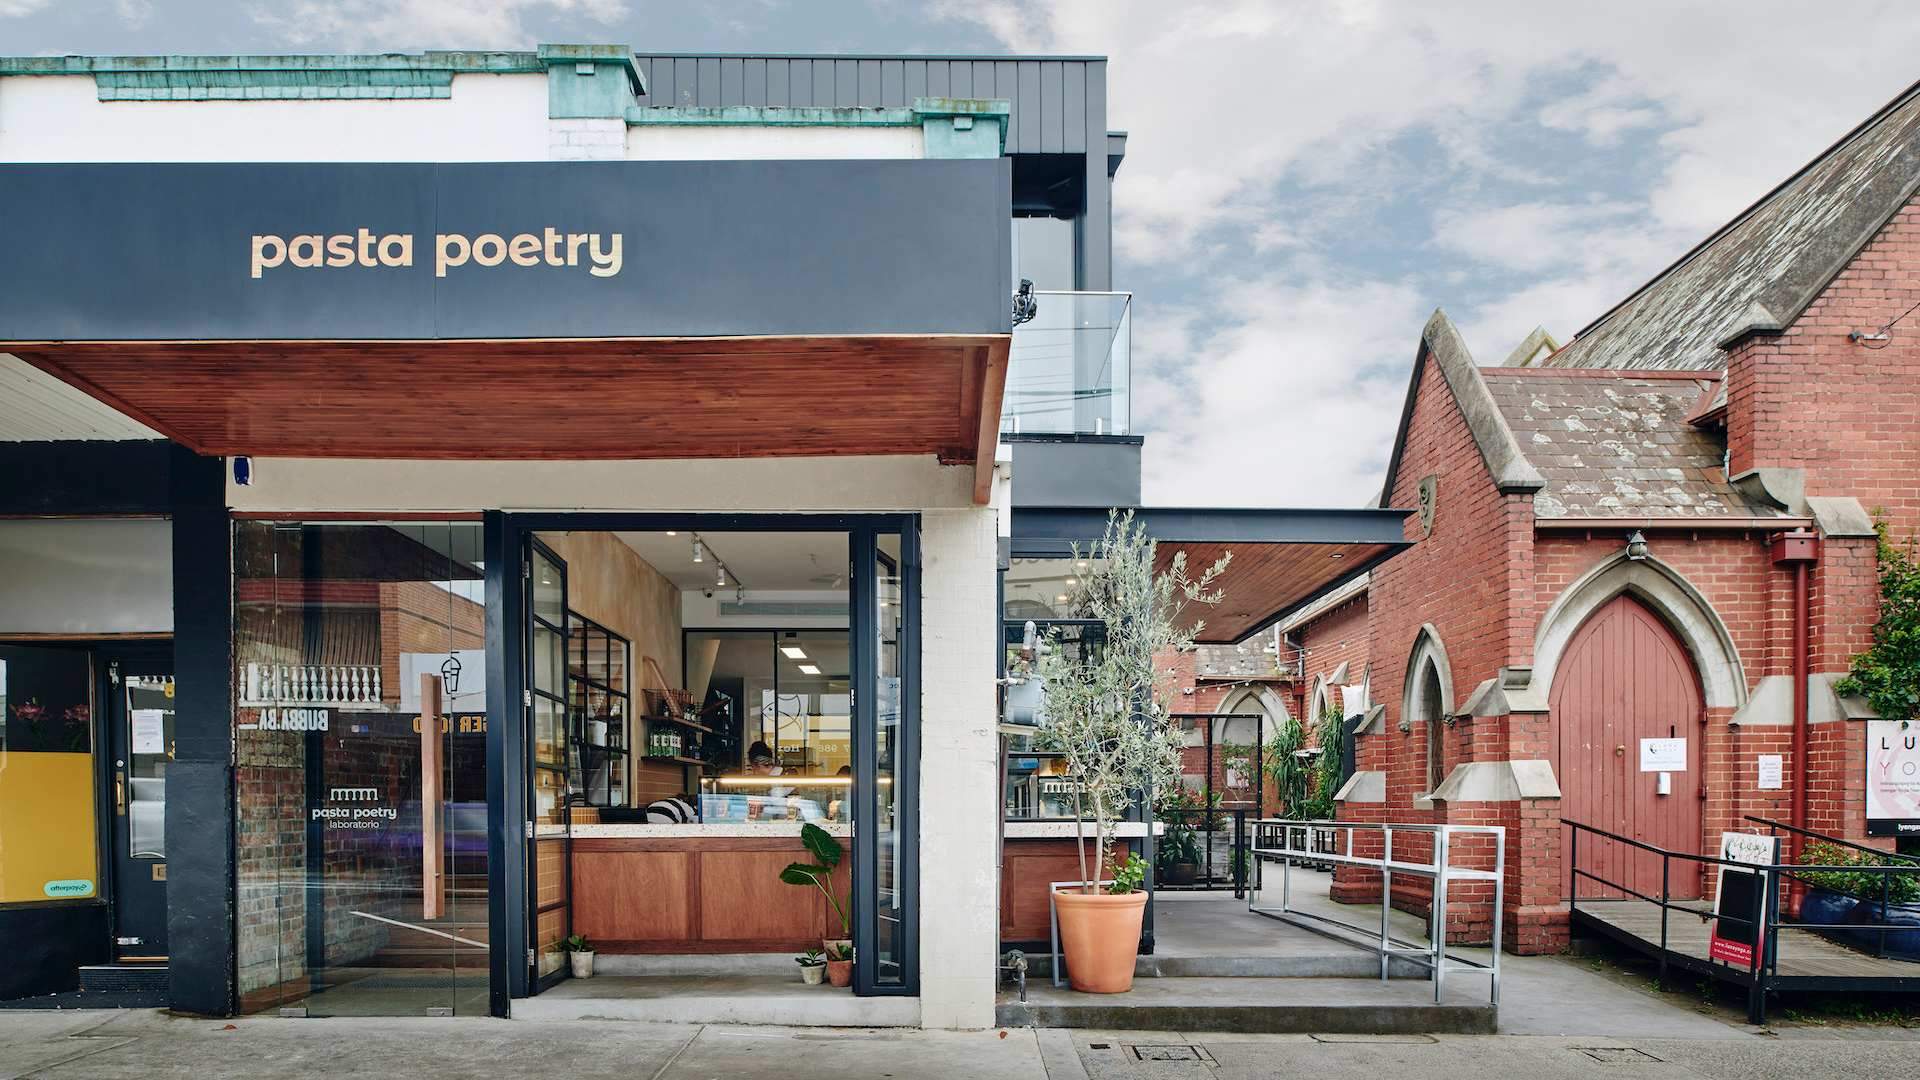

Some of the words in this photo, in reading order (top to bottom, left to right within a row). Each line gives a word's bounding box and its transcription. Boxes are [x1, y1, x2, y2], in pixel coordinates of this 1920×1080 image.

[251, 228, 413, 279] pasta
[435, 227, 623, 278] poetry
[312, 807, 350, 820] pasta
[353, 807, 397, 820] poetry
[329, 820, 380, 829] laboratorio
